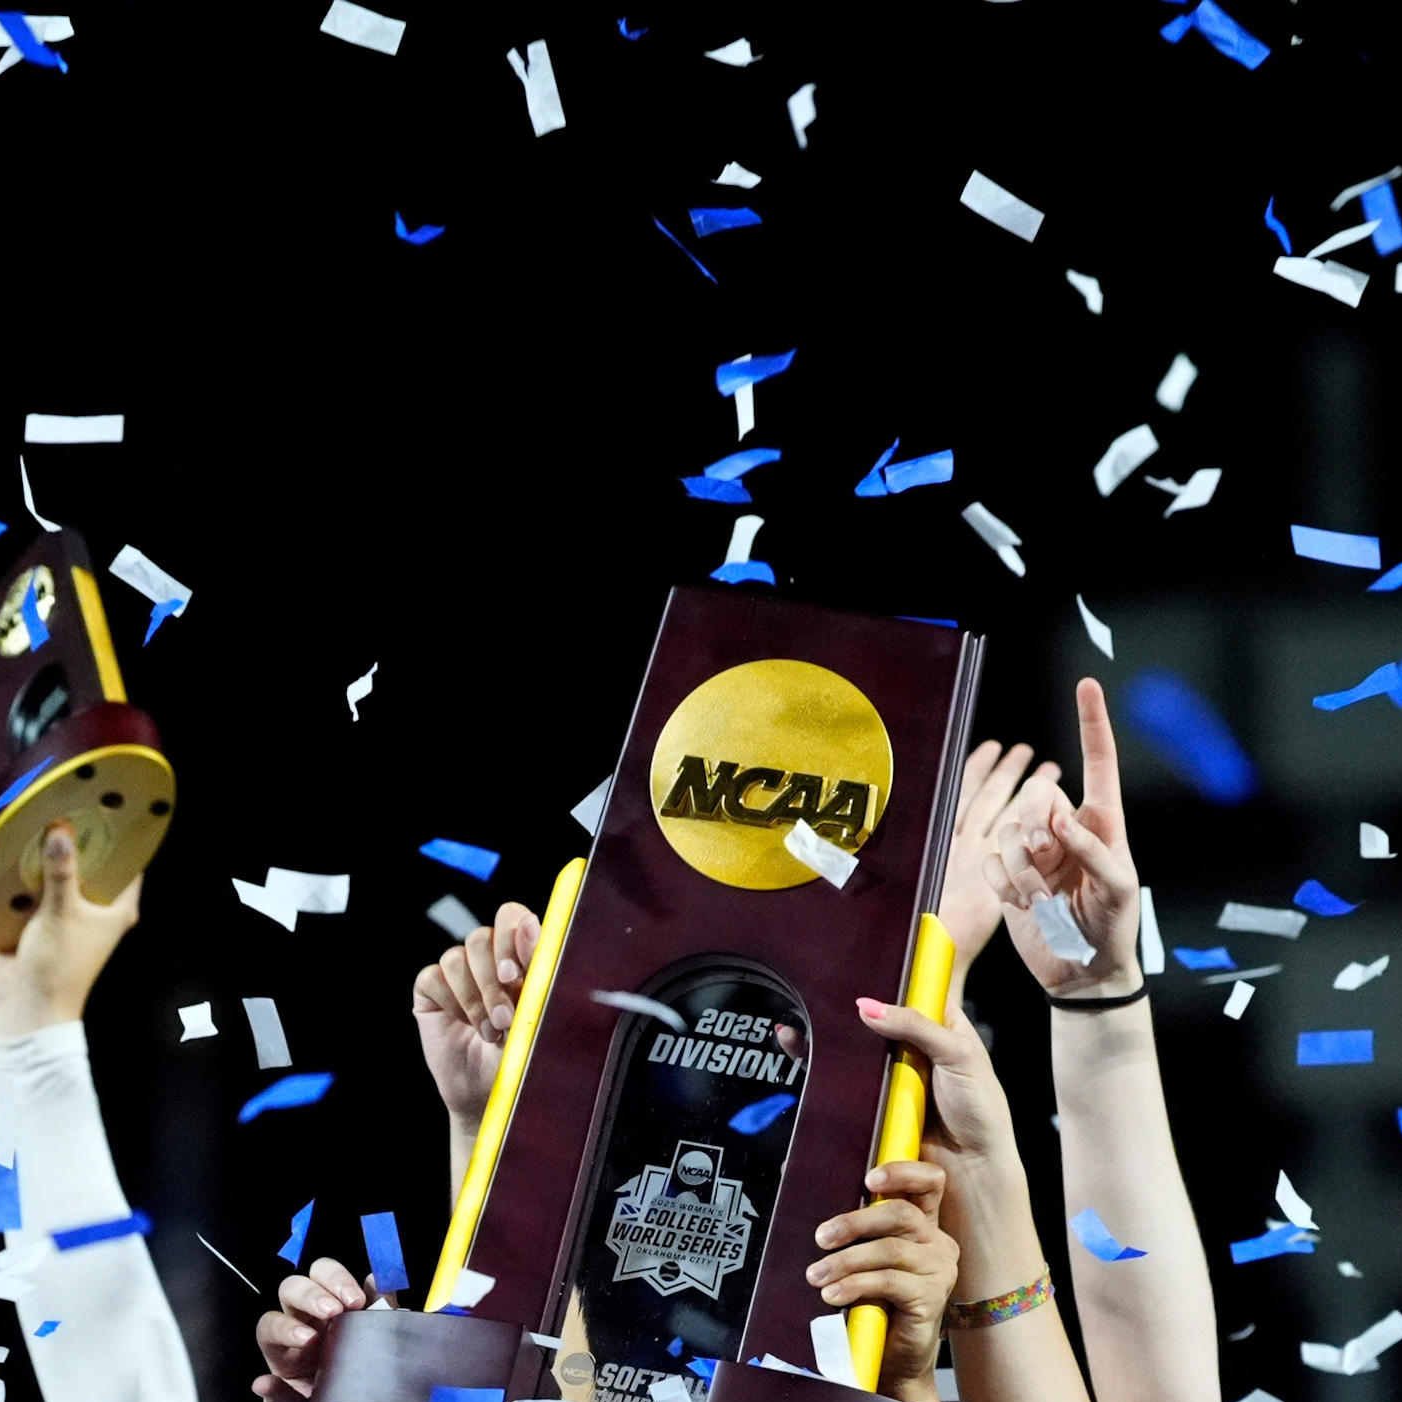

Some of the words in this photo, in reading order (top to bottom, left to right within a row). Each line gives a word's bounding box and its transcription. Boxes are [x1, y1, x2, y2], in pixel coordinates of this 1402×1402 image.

[661, 755, 878, 848] NCAA
[695, 1008, 772, 1043] 2025
[648, 1033, 785, 1083] DIVISION
[785, 1057, 804, 1085] I
[680, 1165, 713, 1181] NCAA
[644, 1208, 723, 1236] COLLEGE
[651, 1198, 676, 1209] 2025
[679, 1203, 724, 1216] WOMEN'S
[612, 1222, 677, 1249] WORLD
[678, 1234, 743, 1260] SERIES
[636, 1246, 687, 1262] OKLAHOMA
[689, 1257, 713, 1265] CITY
